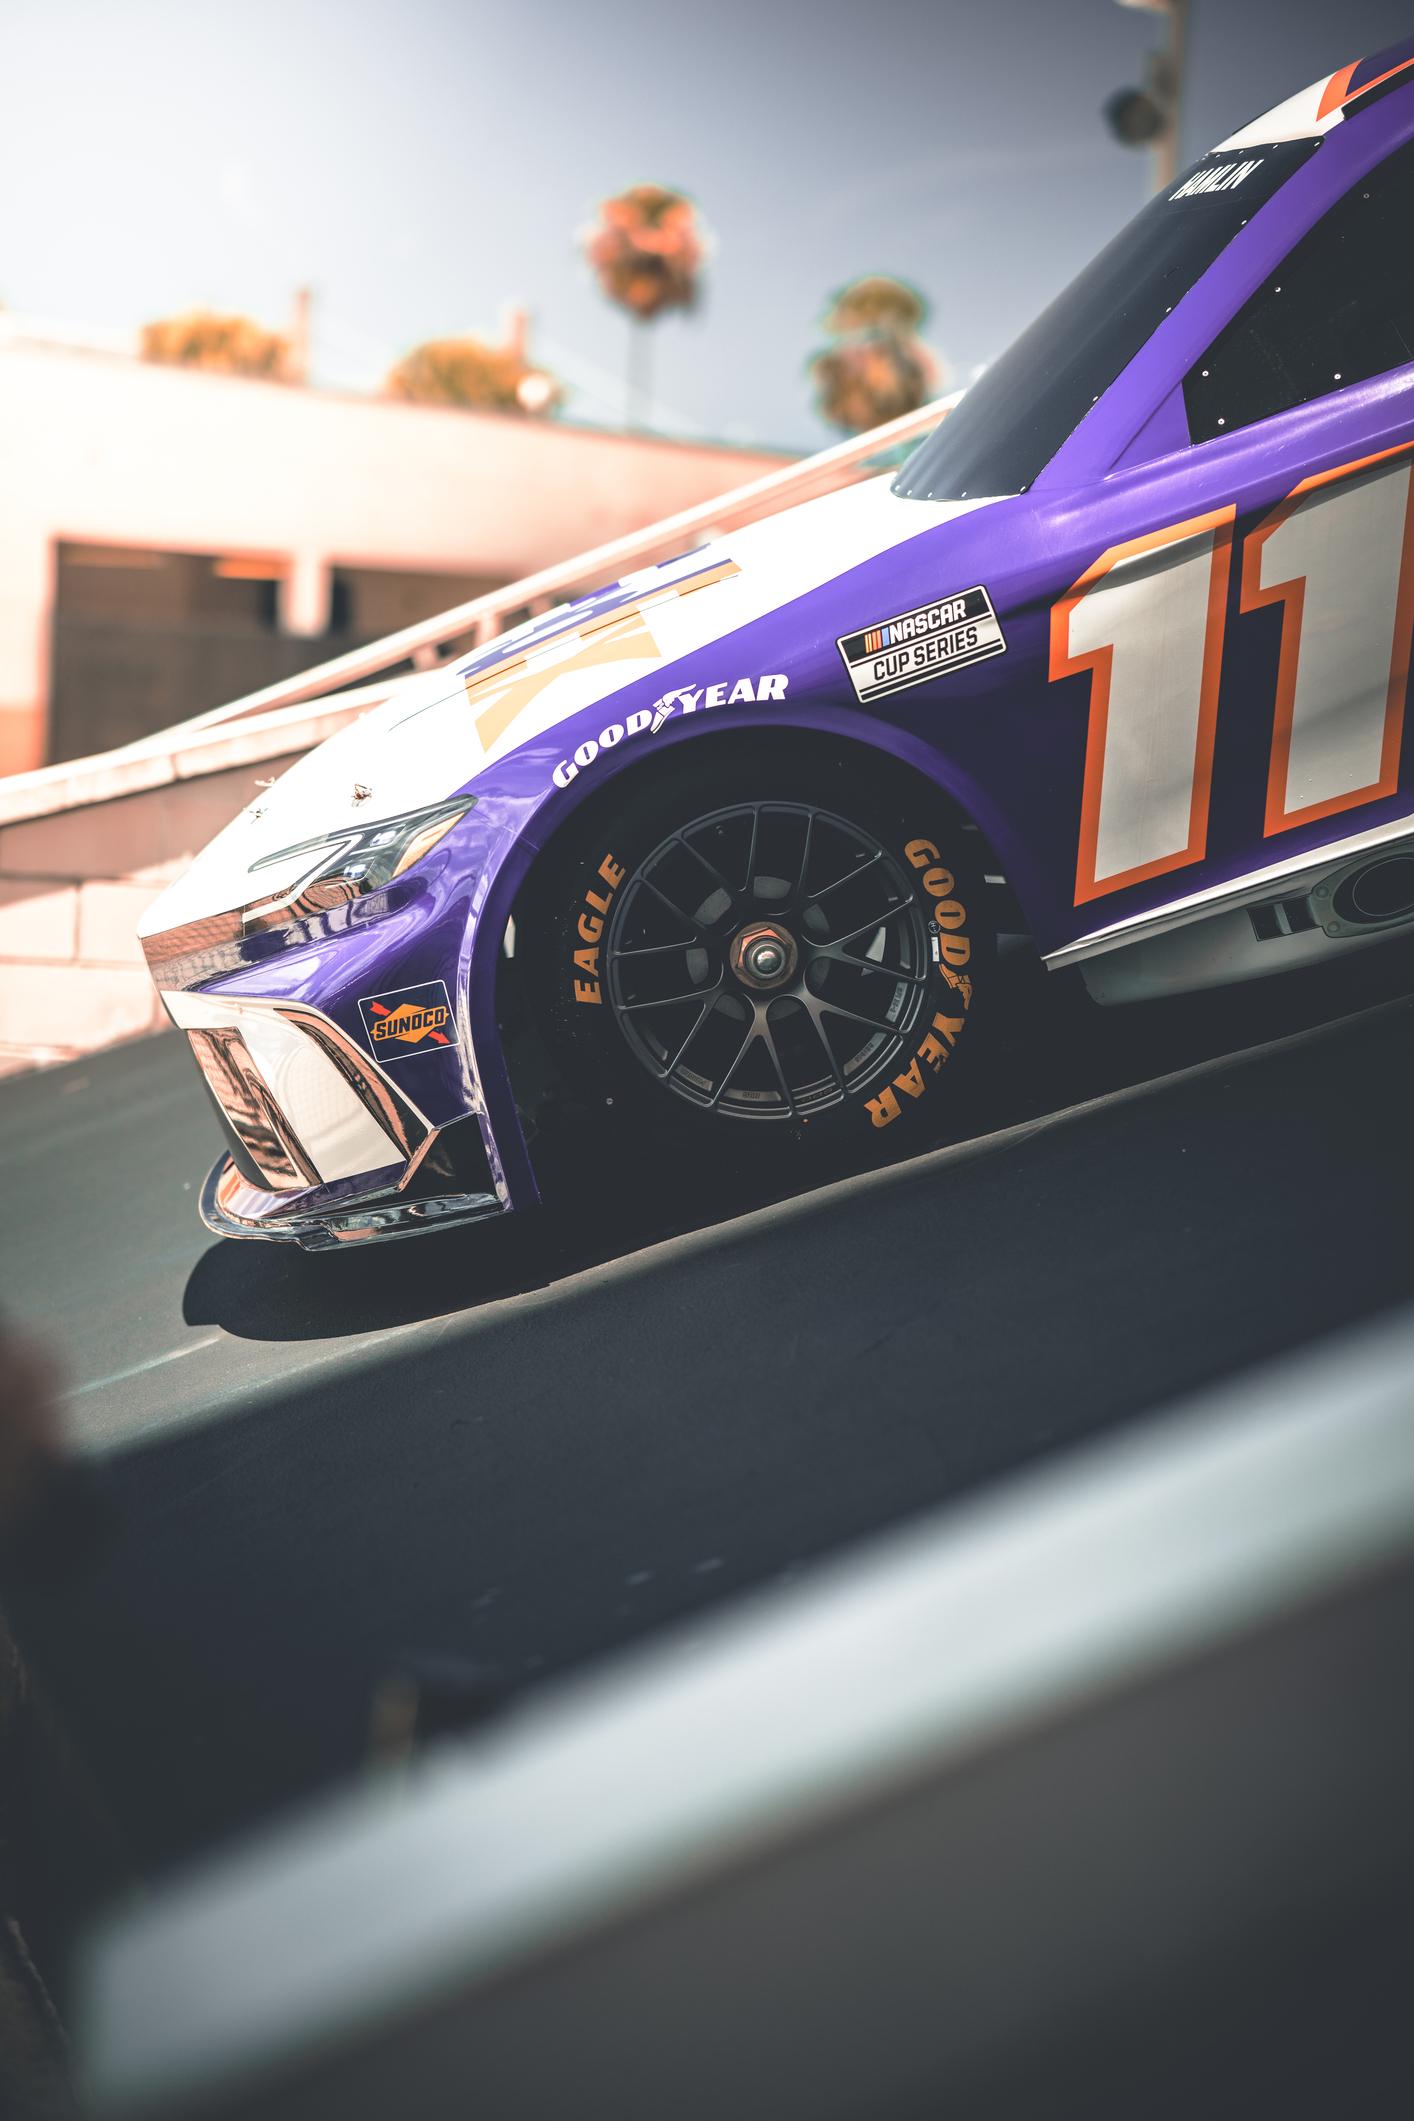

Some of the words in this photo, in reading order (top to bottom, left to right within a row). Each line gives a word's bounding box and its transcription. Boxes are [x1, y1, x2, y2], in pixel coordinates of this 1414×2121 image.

[1168, 159, 1264, 201] HAMLIN
[889, 599, 966, 645] NASCAR
[873, 651, 910, 681] CUP
[913, 626, 978, 666] SERIES
[1048, 440, 1414, 907] 11
[573, 853, 626, 1004] EAGLE
[375, 1008, 446, 1039] SUNOCO
